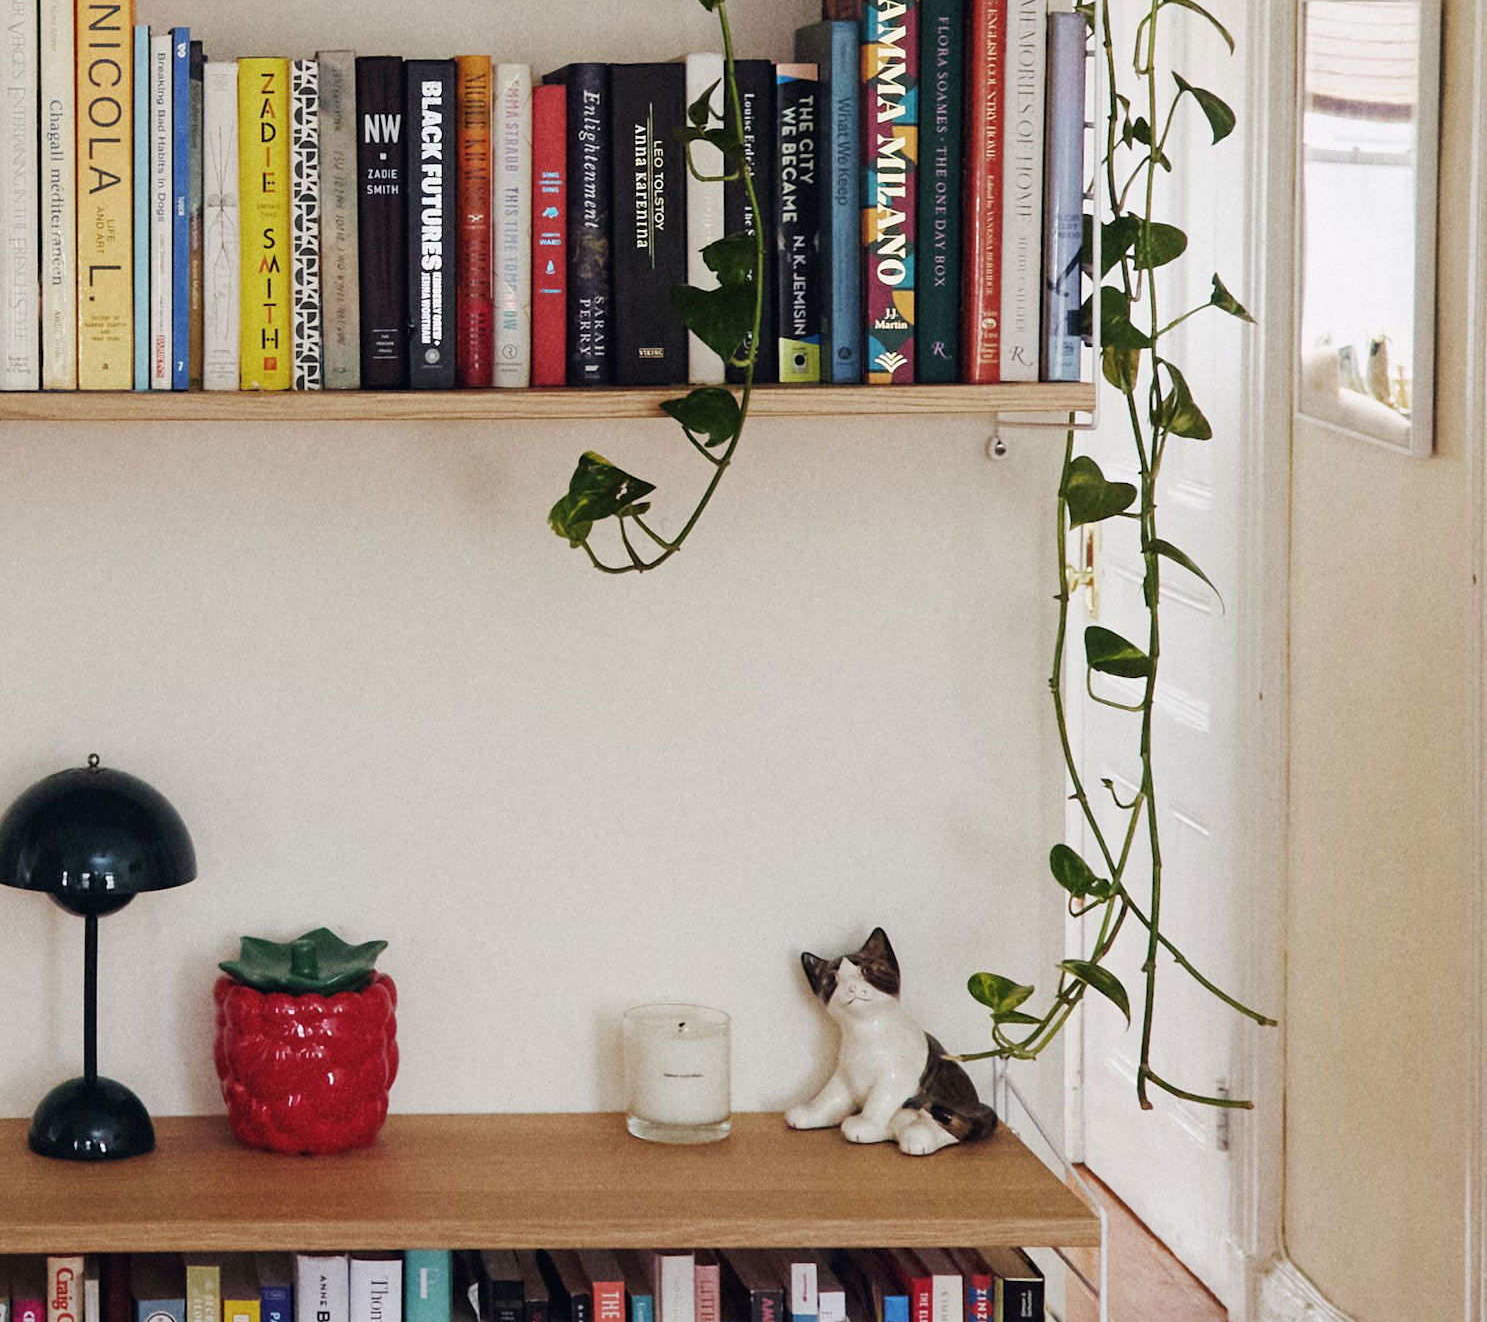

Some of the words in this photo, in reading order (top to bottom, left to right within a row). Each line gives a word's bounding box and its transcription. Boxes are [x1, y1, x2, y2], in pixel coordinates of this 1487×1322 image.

[935, 16, 950, 68] FLORA
[155, 52, 167, 105] Breaking
[88, 4, 122, 196] NICOLA
[743, 93, 756, 135] Louise
[799, 95, 814, 132] THE
[837, 97, 852, 139] What
[935, 72, 949, 133] SOAMES
[46, 99, 64, 162] Chagall
[157, 109, 167, 133] Bad
[364, 113, 401, 144] NW
[420, 80, 443, 160] BLACK
[781, 107, 797, 136] WE
[157, 136, 167, 174] Habits
[504, 123, 519, 172] STRAUB
[580, 89, 601, 229] Enlightenment
[653, 140, 663, 168] LEO
[798, 138, 814, 185] CITY
[935, 146, 948, 178] THE
[366, 185, 399, 195] SMITH
[653, 172, 664, 231] TOLSTOY
[781, 141, 797, 224] BECAME
[833, 168, 852, 206] Keep
[935, 182, 947, 214] ONE
[96, 206, 105, 227] AND
[155, 192, 167, 223] Dogs
[421, 164, 443, 271] FUTURES
[504, 187, 519, 217] THIS
[876, 134, 907, 286] MILANO
[96, 232, 105, 255] ART
[106, 218, 116, 242] LIFE
[504, 221, 518, 253] TIME
[934, 219, 947, 250] DAY
[88, 264, 122, 302] L.
[933, 255, 946, 288] BOX
[793, 272, 807, 335] JEMISIN
[578, 298, 591, 357] PERRY
[593, 295, 606, 357] SARAH
[52, 1267, 74, 1310] Craig
[600, 1291, 621, 1320] THE
